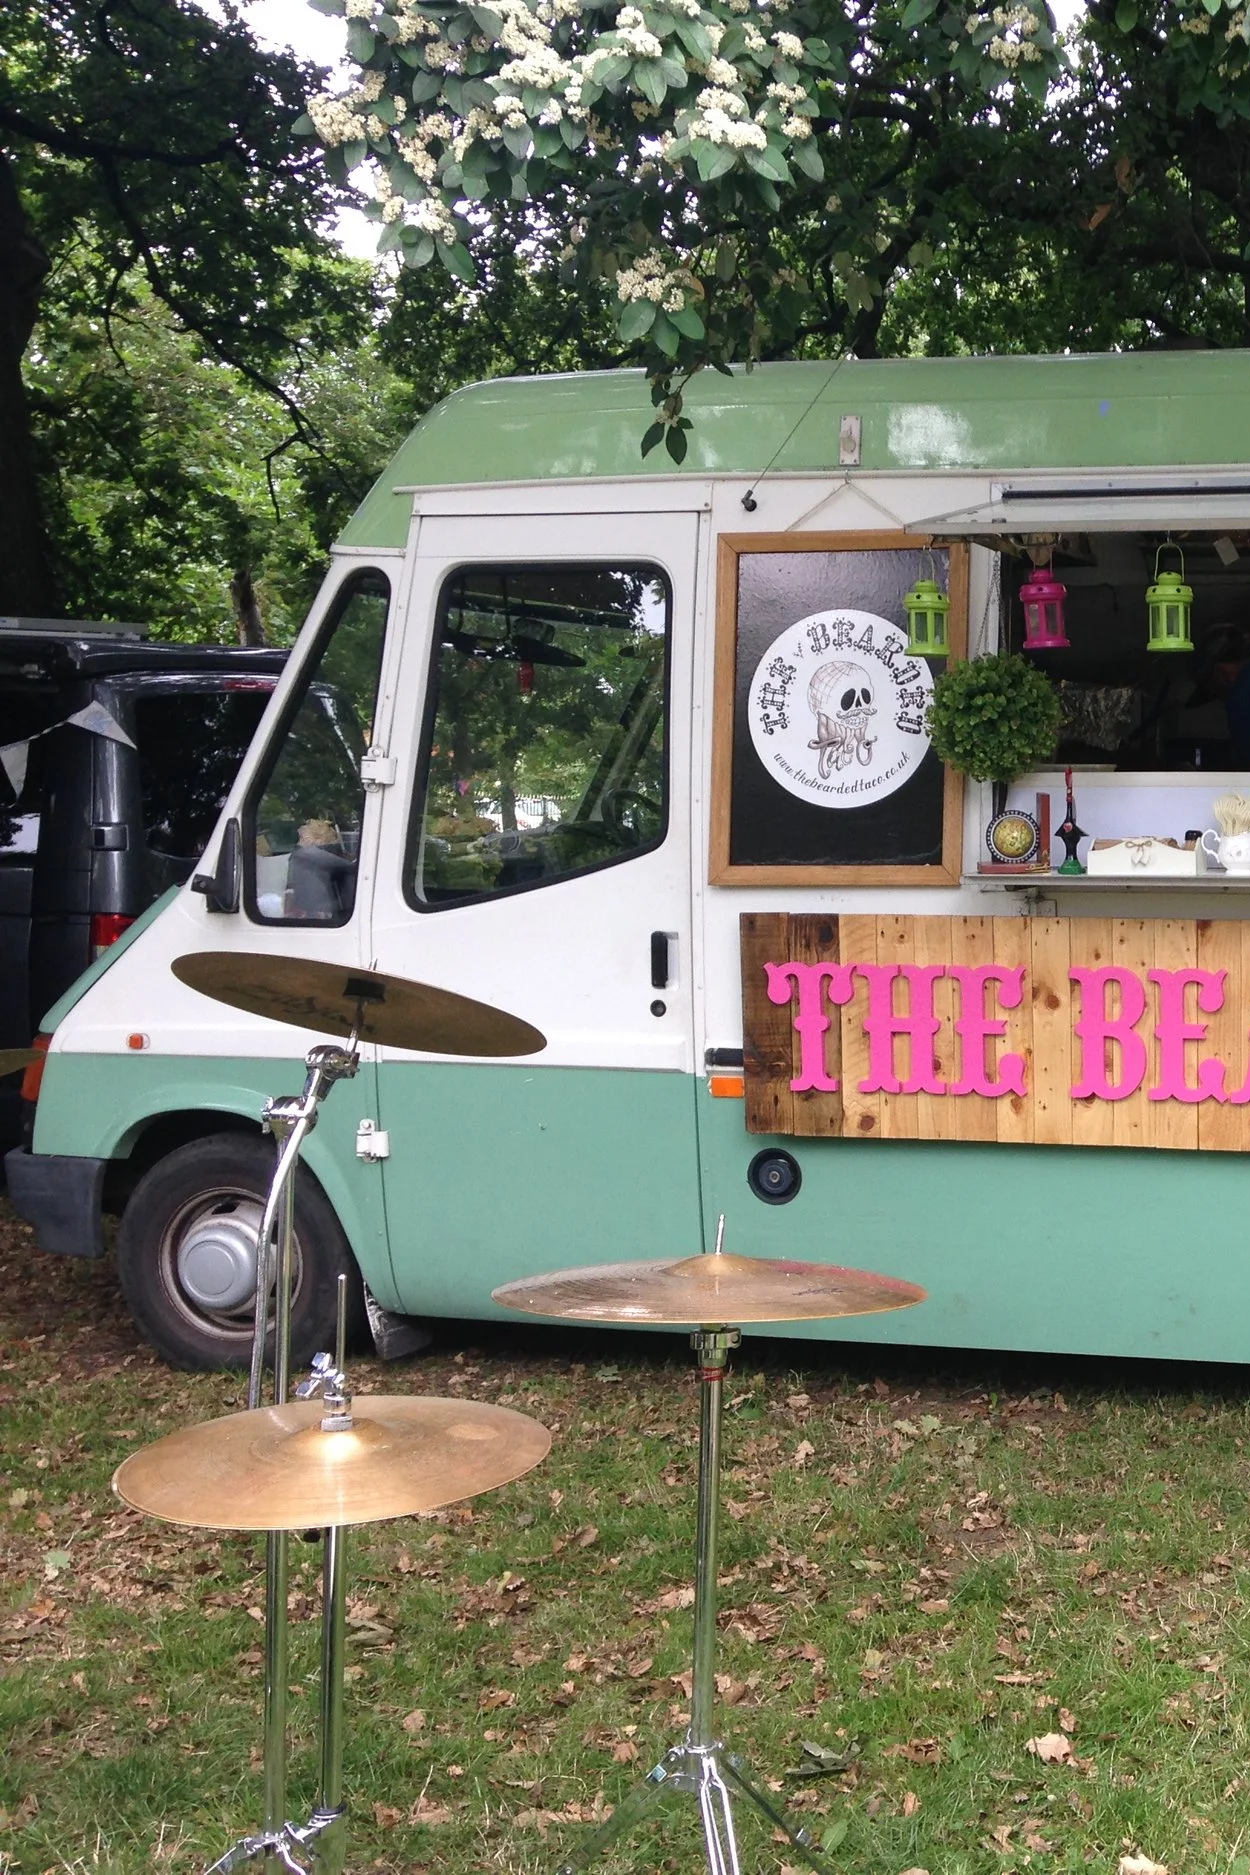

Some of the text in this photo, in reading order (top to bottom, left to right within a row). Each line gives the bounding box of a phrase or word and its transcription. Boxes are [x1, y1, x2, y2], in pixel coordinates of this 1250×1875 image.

[757, 617, 929, 736] THE BEARDED
[773, 751, 911, 795] www.thebeardedtaco.co.uk
[762, 960, 1028, 1097] THE
